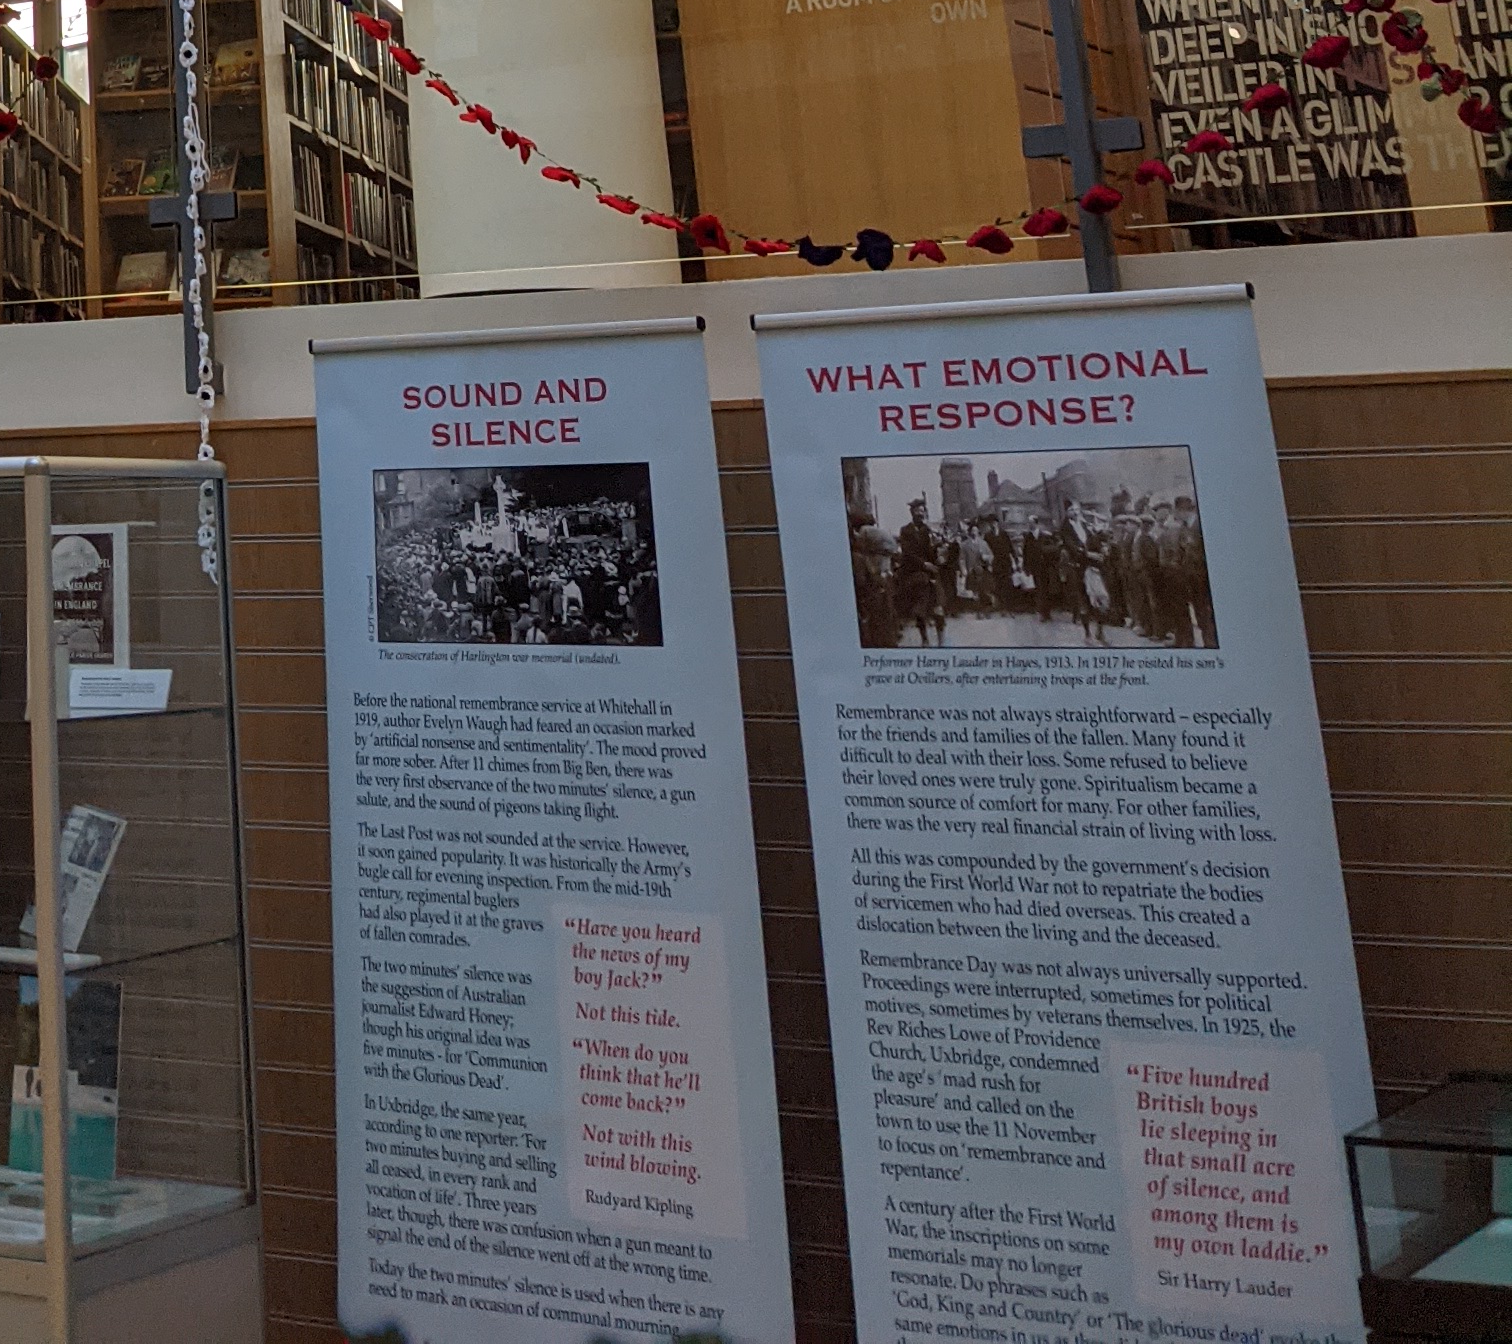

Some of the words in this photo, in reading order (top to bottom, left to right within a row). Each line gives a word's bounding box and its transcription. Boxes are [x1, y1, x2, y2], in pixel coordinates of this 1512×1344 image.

[1166, 145, 1316, 190] CASTLE
[1316, 138, 1410, 180] WAS
[805, 360, 927, 393] WHAT
[941, 346, 1209, 386] EMOTIONAL
[402, 381, 522, 409] SOUND
[533, 377, 607, 403] AND
[878, 394, 1135, 431] RESPONSE?
[430, 417, 580, 447] SILENCE
[353, 691, 387, 706] Before
[389, 692, 407, 706] the
[409, 693, 455, 708] national
[459, 694, 538, 710] remembrance
[540, 700, 582, 711] service
[583, 700, 597, 712] at
[598, 698, 656, 714] Whitehall
[659, 700, 672, 714] in
[835, 704, 935, 720] Remembrance
[940, 711, 968, 720] was
[971, 710, 995, 721] not
[998, 707, 1051, 726] always
[1055, 708, 1175, 729] straightforward
[1191, 710, 1272, 731] especially
[622, 928, 651, 945] you
[655, 924, 701, 943] heard
[575, 1001, 606, 1020] Not
[610, 1005, 640, 1023] this
[1188, 1067, 1269, 1091] hundred
[1137, 1092, 1204, 1114] British
[1211, 1096, 1258, 1123] boys
[585, 1188, 641, 1212] Rudyard
[645, 1194, 694, 1219] Kipling
[1157, 1270, 1179, 1286] Sir
[1184, 1273, 1231, 1296] Harry
[1237, 1277, 1292, 1297] Lauder
